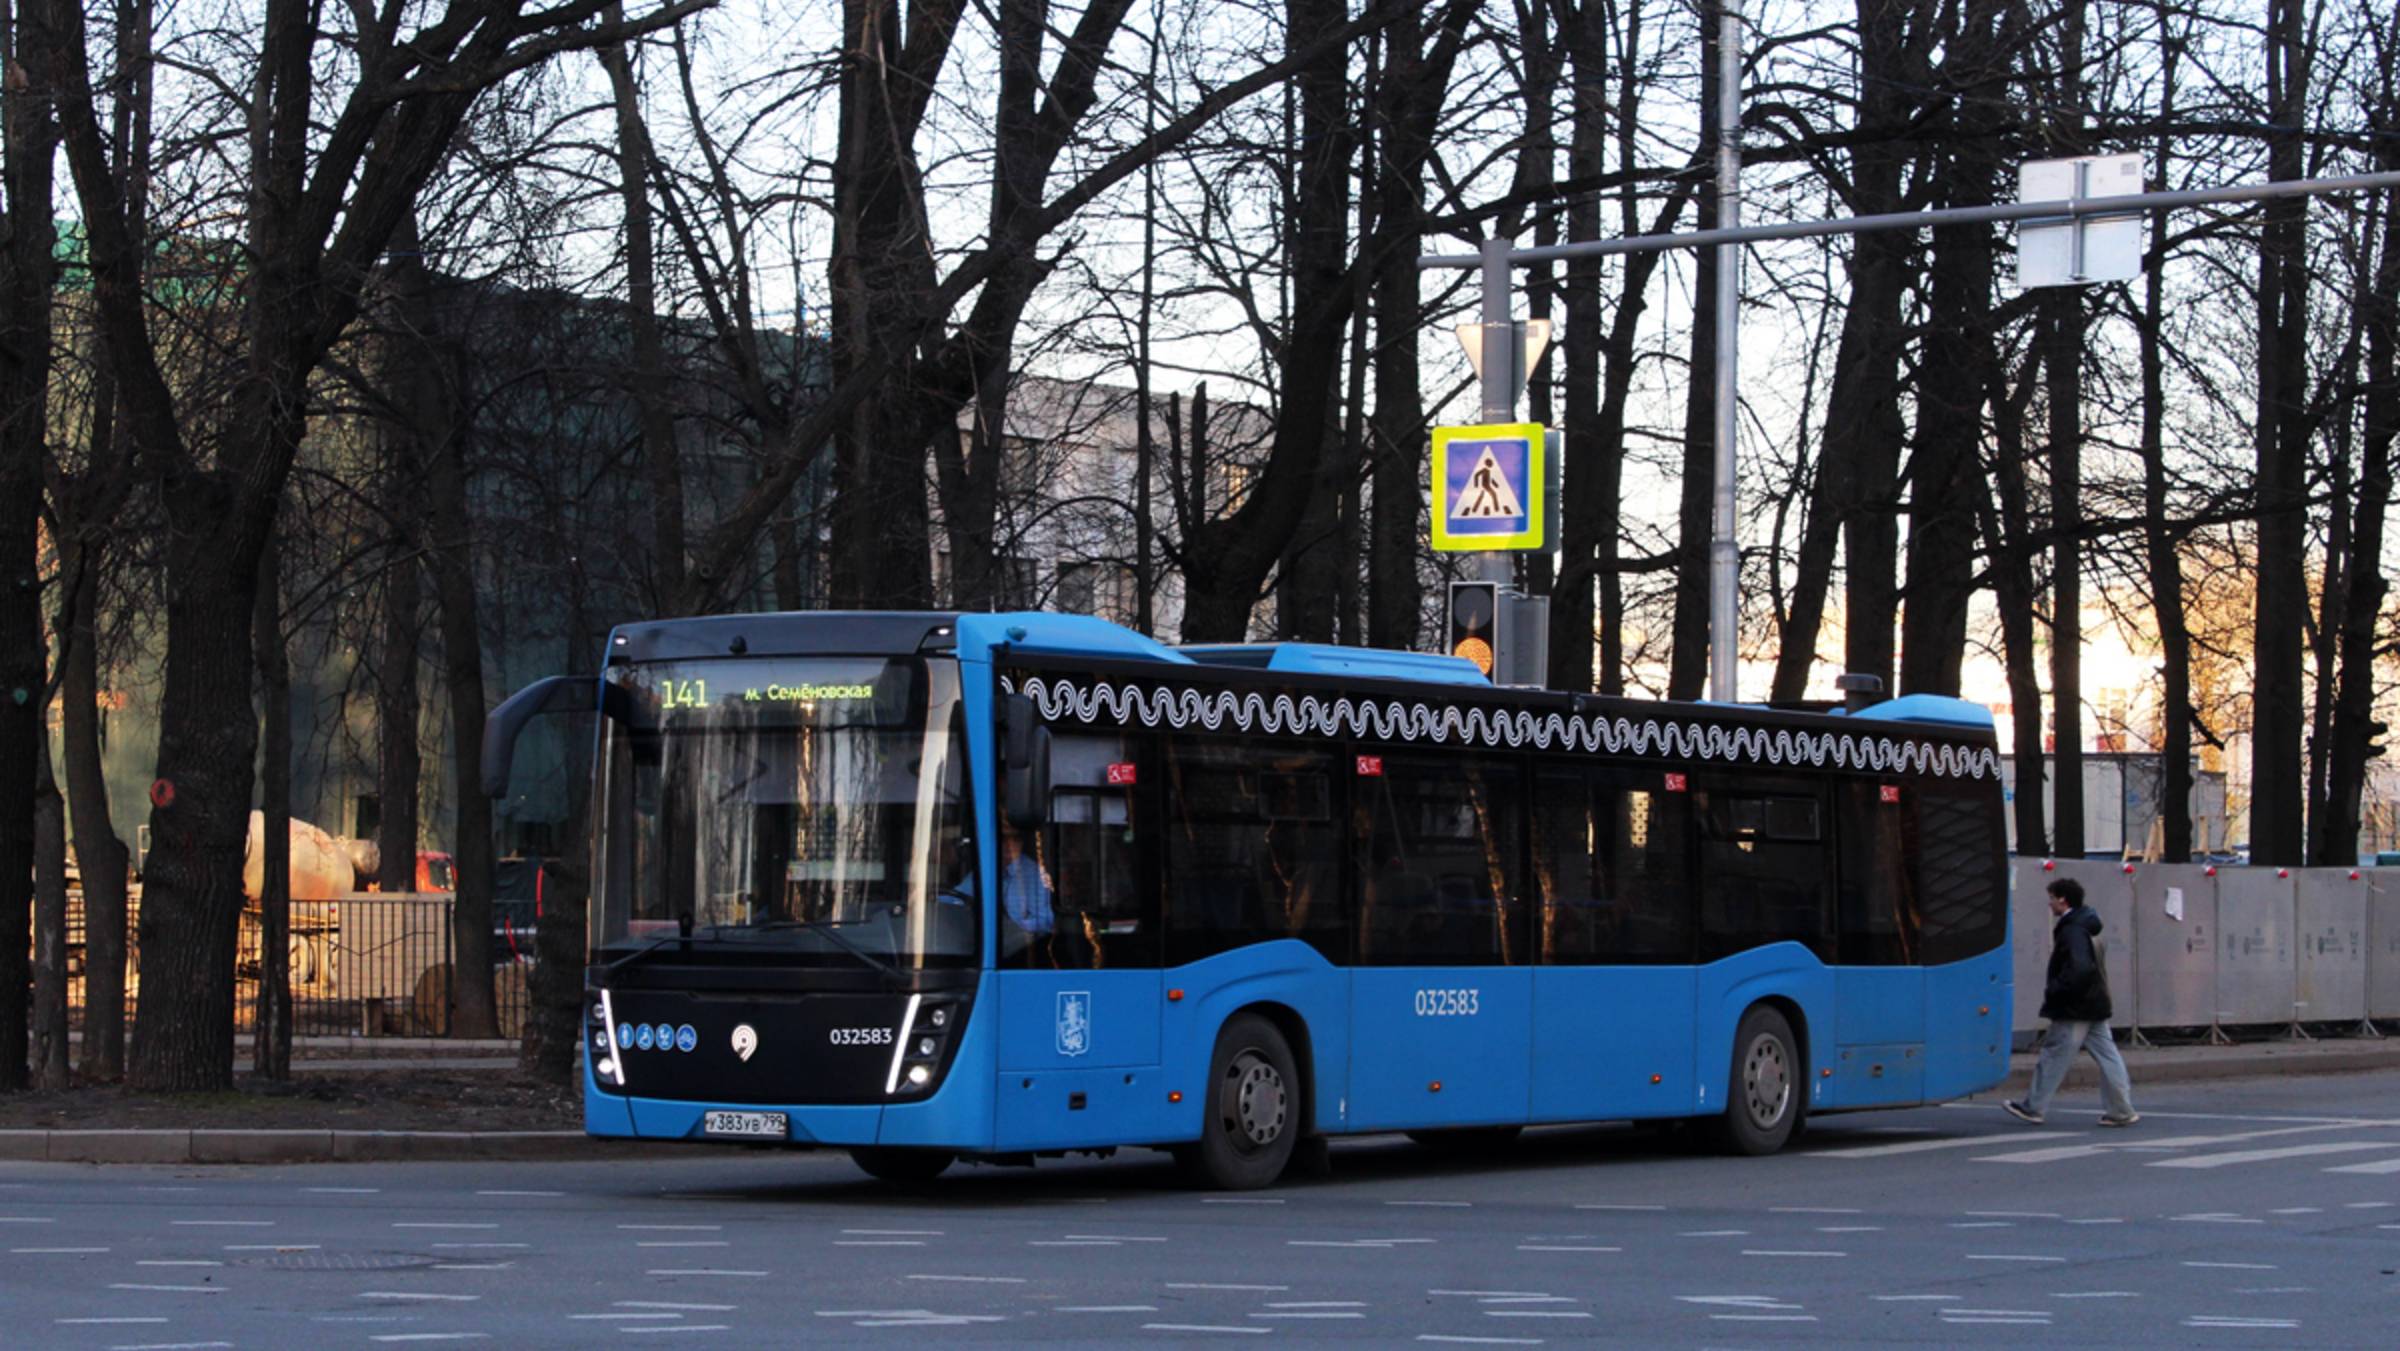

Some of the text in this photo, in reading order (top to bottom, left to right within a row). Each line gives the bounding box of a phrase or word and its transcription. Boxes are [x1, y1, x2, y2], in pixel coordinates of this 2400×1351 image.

[661, 679, 709, 709] 141
[767, 683, 873, 701] Семёновская
[1415, 989, 1479, 1016] 032583
[829, 1028, 893, 1045] 032583
